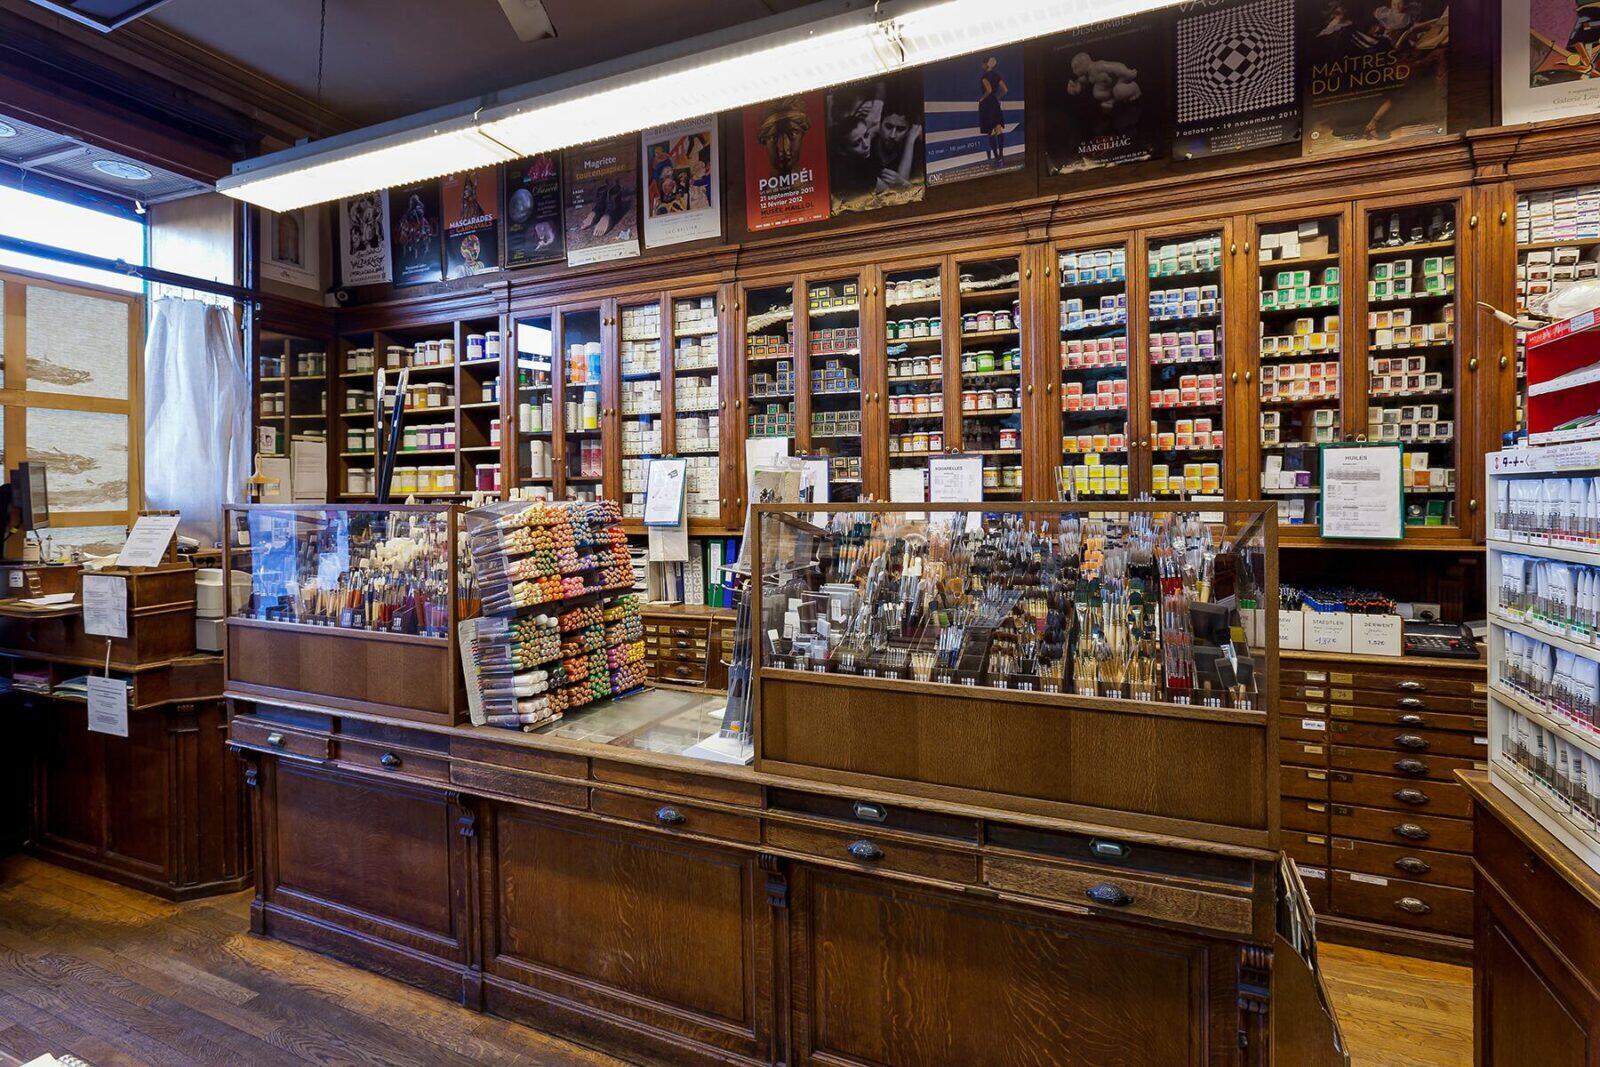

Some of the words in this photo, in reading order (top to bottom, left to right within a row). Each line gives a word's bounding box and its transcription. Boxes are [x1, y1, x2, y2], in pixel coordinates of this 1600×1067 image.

[1312, 50, 1398, 81] MAÎTRES
[1312, 80, 1341, 96] DU
[1350, 65, 1411, 89] NORD
[1183, 127, 1214, 136] octobre
[1234, 115, 1276, 128] novembre
[1278, 110, 1298, 119] 2011
[1078, 137, 1131, 153] MARCILHAC
[584, 155, 617, 169] Magritte
[759, 168, 813, 191] POMPÉI
[767, 190, 800, 201] septembre
[801, 186, 815, 194] 2011
[767, 199, 788, 208] février
[788, 196, 803, 204] 2012
[449, 213, 493, 229] MASCARADES
